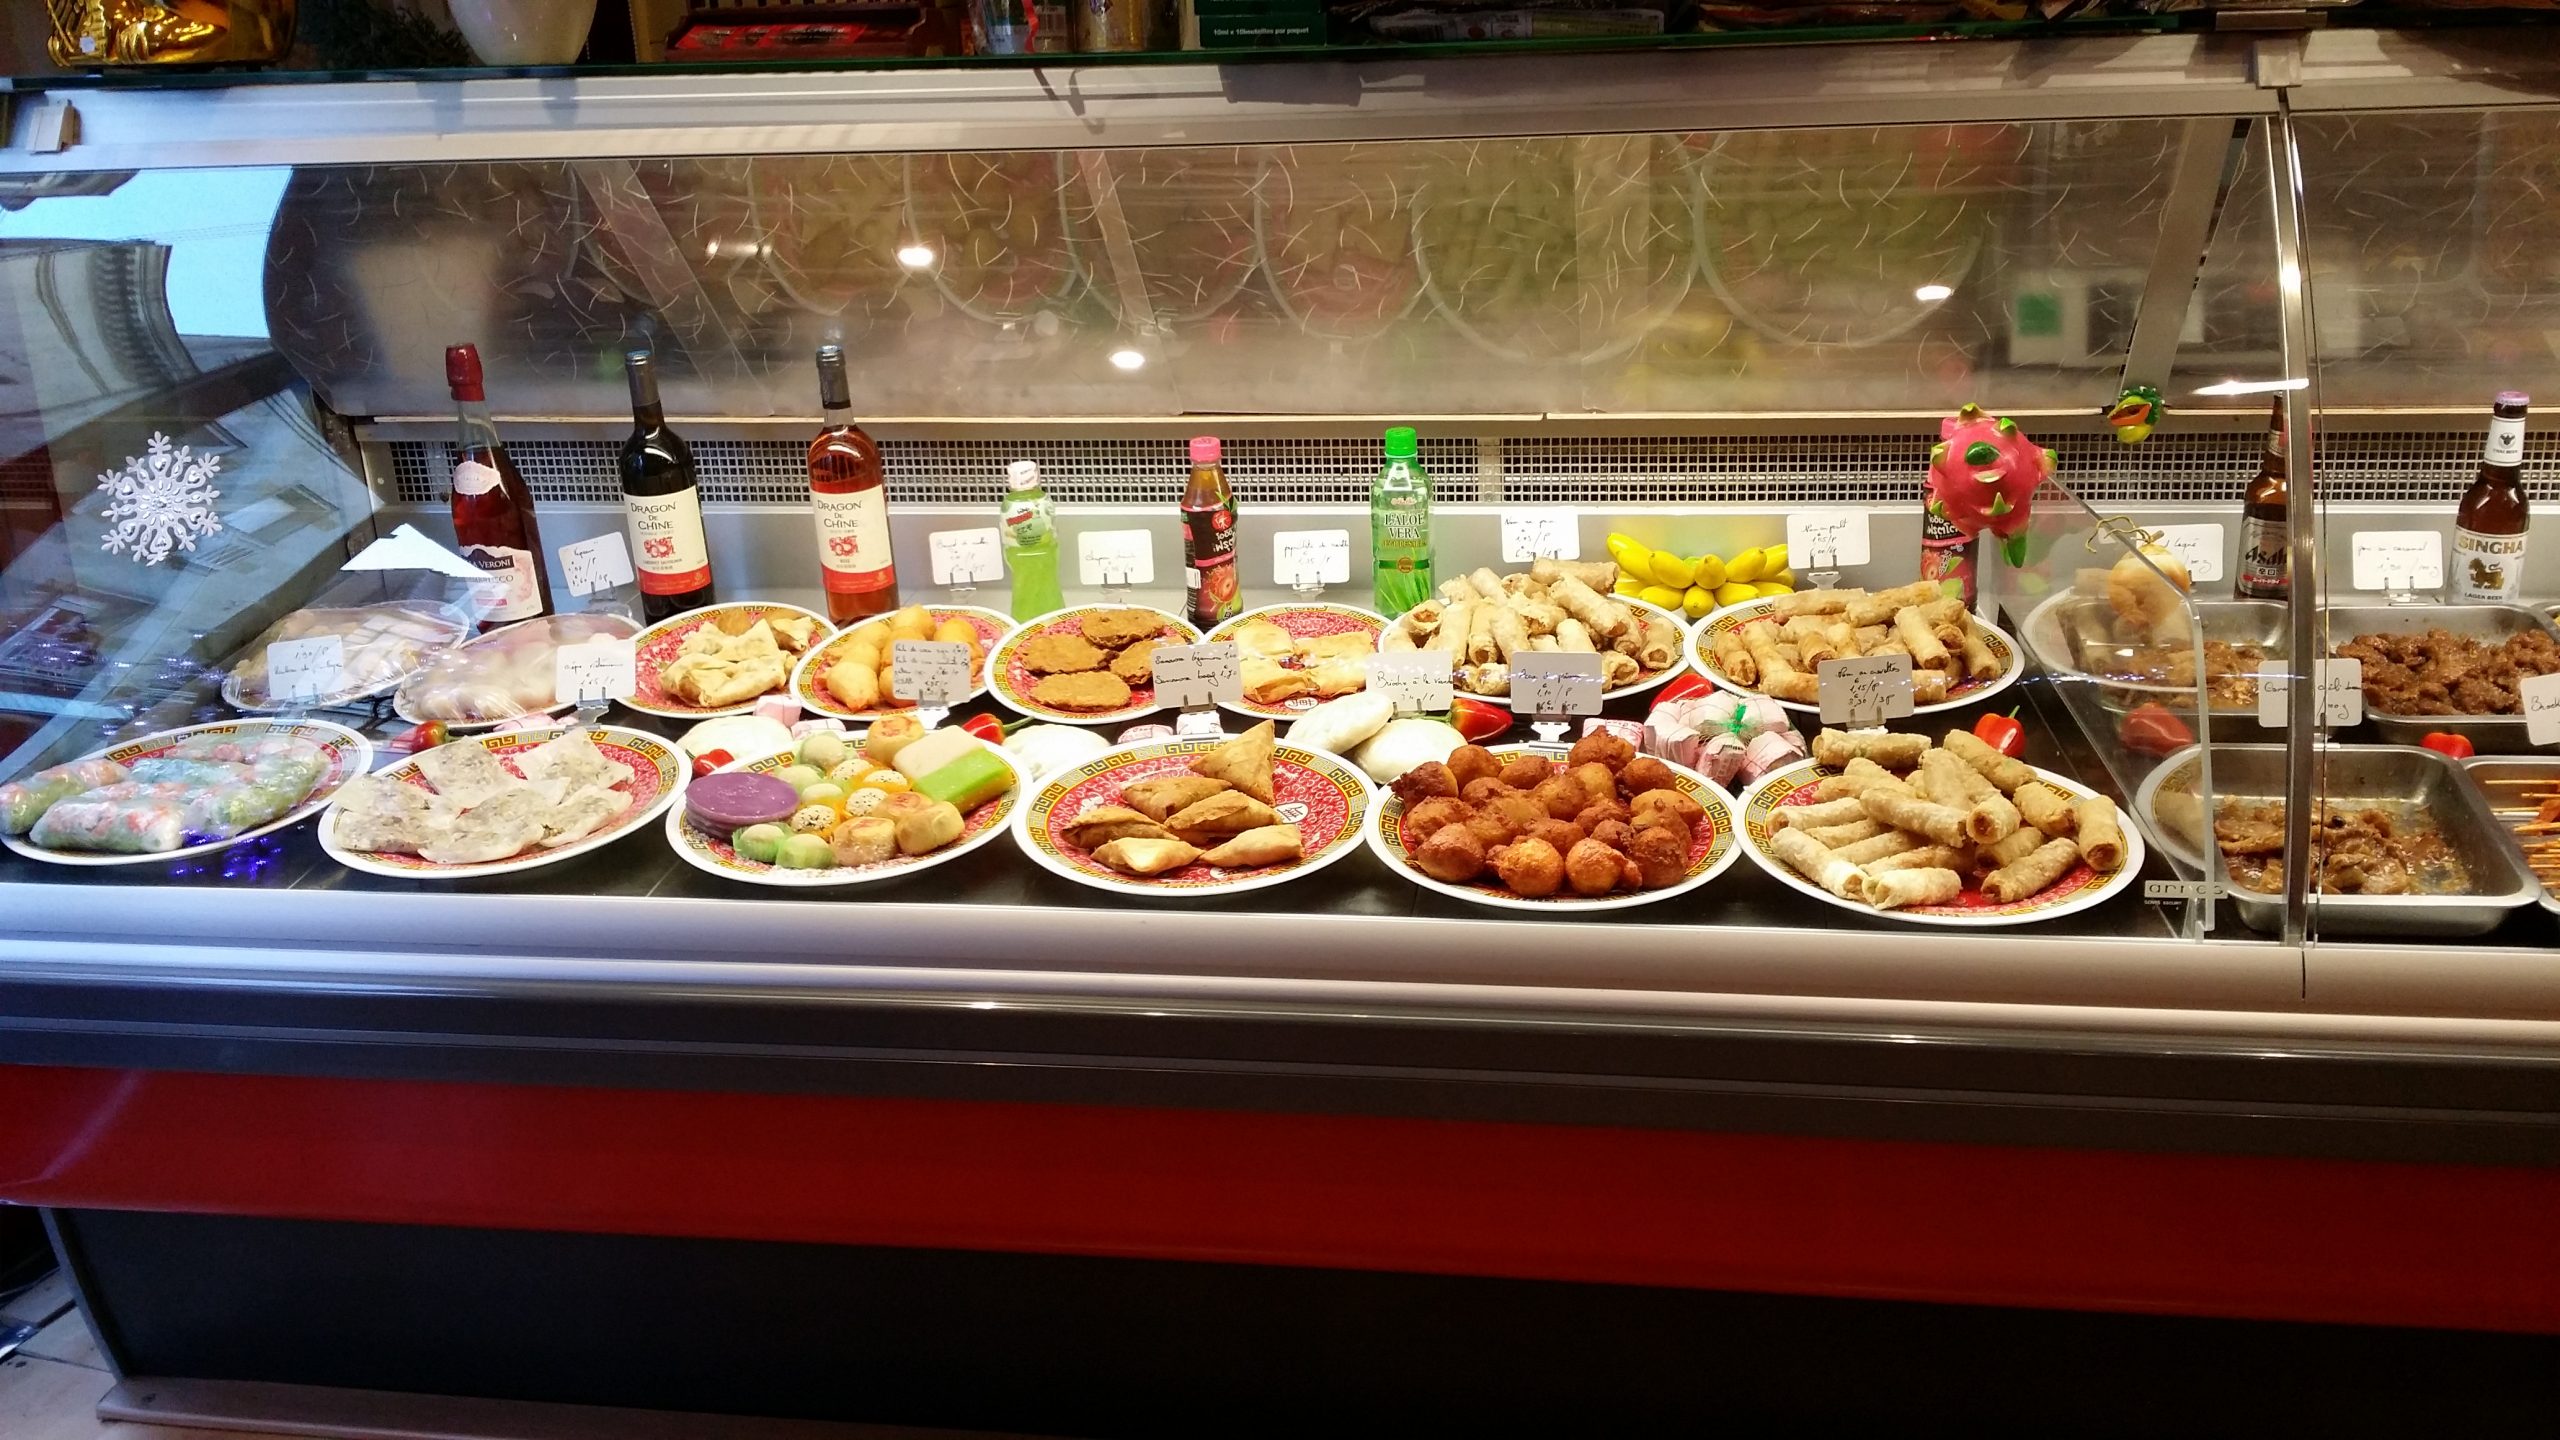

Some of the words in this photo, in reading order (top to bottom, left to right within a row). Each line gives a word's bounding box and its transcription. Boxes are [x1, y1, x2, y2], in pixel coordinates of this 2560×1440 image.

[630, 501, 676, 514] DRAGON
[817, 499, 861, 512] DRAGON
[638, 520, 674, 530] CHINE
[823, 518, 859, 528] CHINE
[1389, 527, 1421, 539] VERA
[2458, 536, 2523, 555] SINGHA
[479, 558, 511, 569] VERONI
[2464, 592, 2486, 600] LAGER
